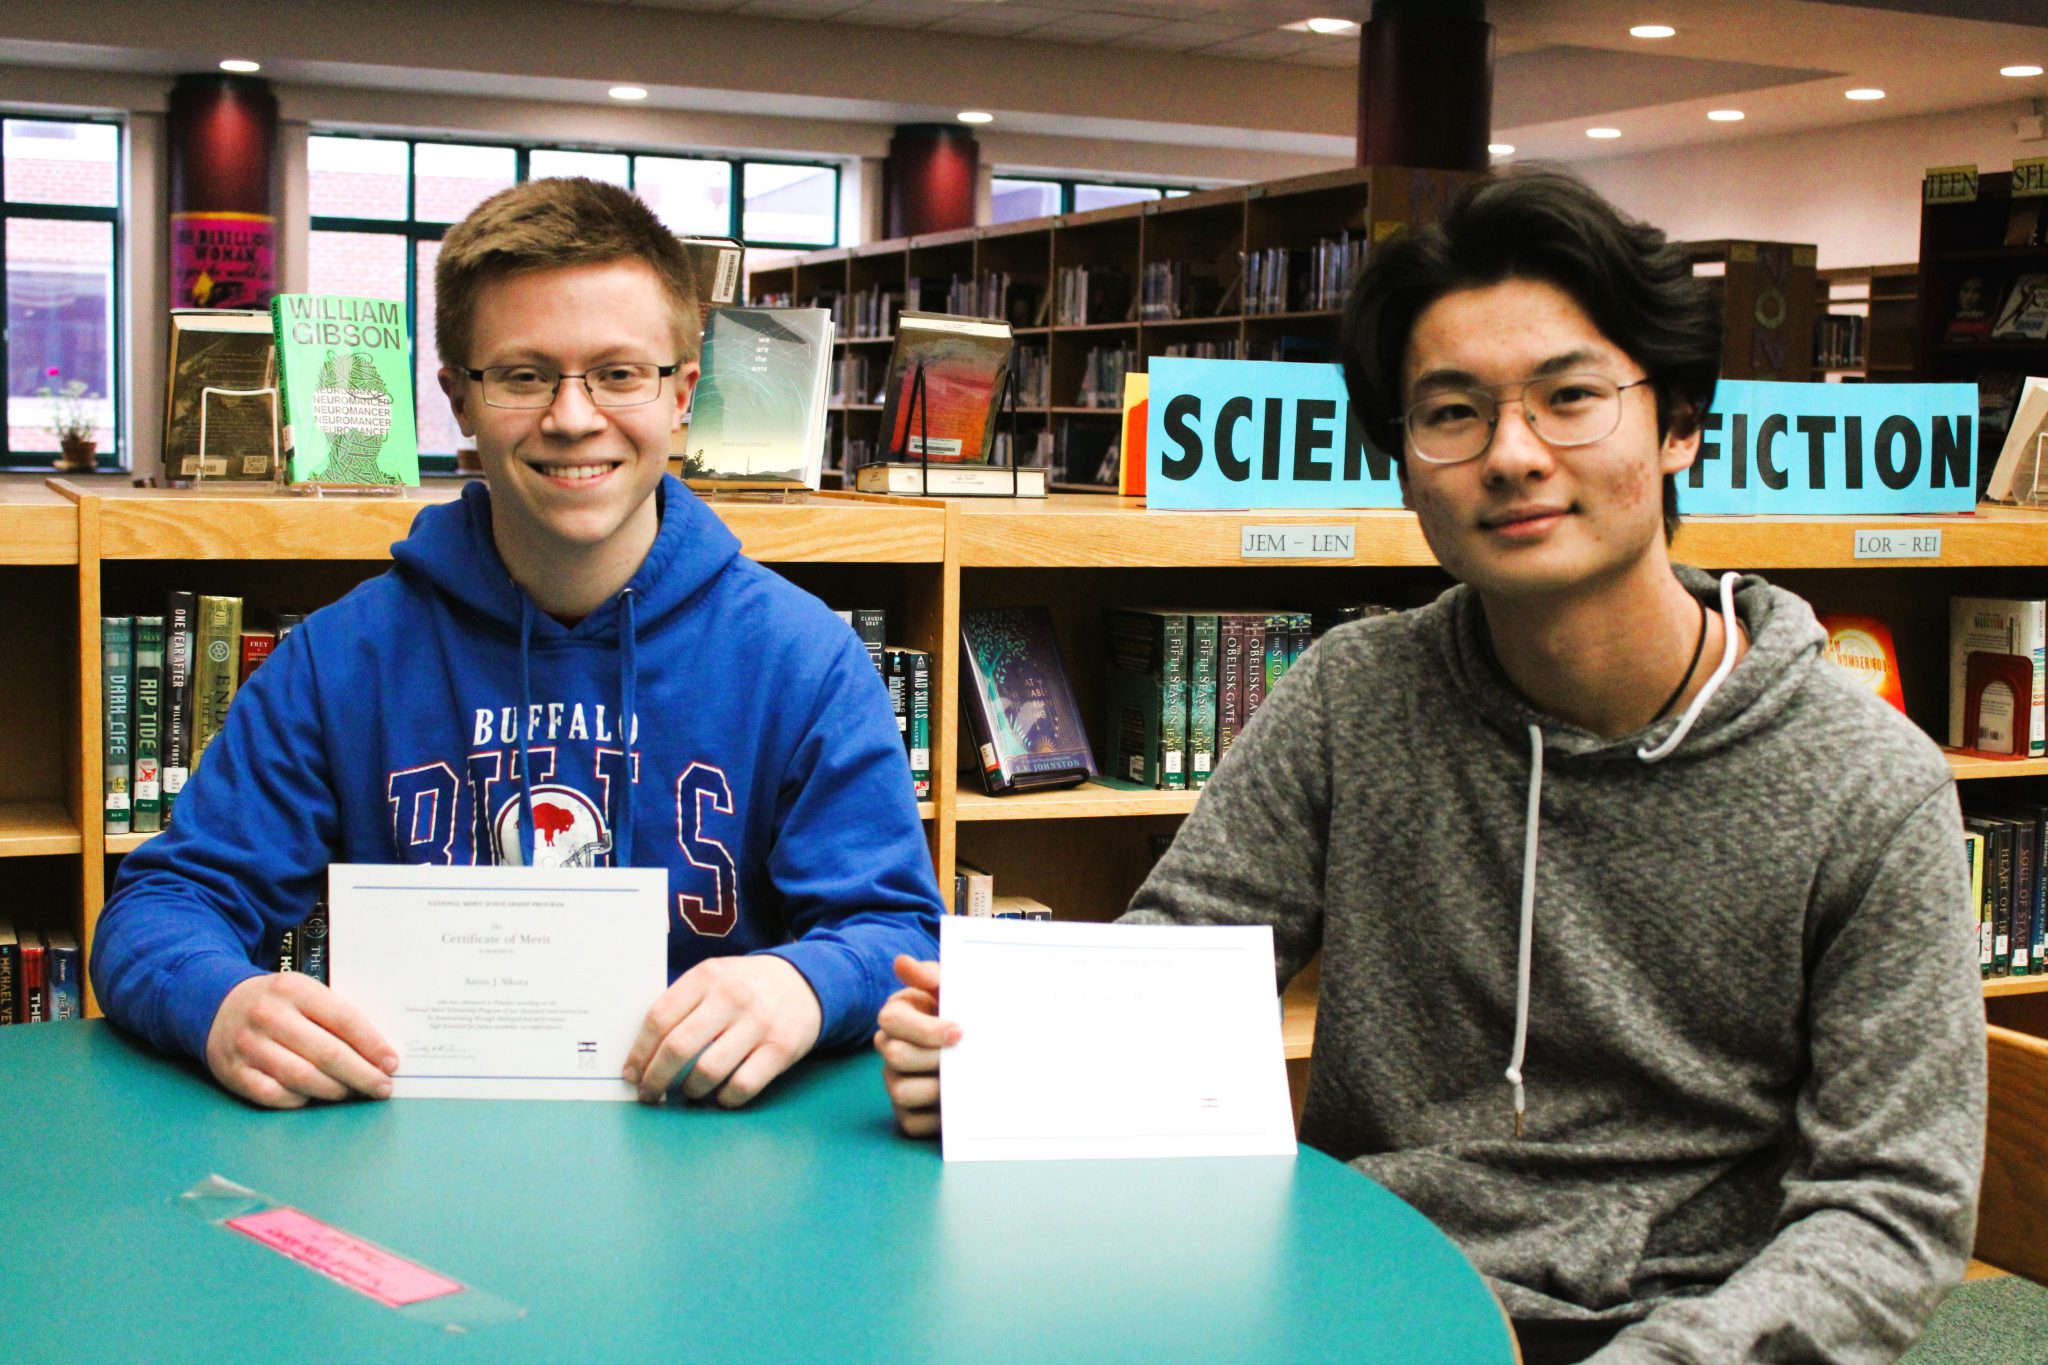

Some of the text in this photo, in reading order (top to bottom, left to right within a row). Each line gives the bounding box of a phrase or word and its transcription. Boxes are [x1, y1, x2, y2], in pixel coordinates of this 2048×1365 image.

[1927, 171, 1977, 199] TEEN
[289, 298, 399, 325] WILLIAM
[293, 323, 401, 350] GIBSON
[313, 395, 391, 407] NEUROMANCER
[313, 405, 391, 417] NEUROMANCER
[314, 415, 392, 427] NEUROMANCER
[1688, 413, 1972, 491] FICTION
[1245, 534, 1286, 552] JEM
[1312, 534, 1351, 552] LEN
[1858, 537, 1891, 553] LOR
[1912, 536, 1938, 552] REI
[174, 608, 186, 628] ONE
[173, 631, 186, 657] YEAR
[1169, 638, 1181, 672] FIFTH
[1199, 638, 1210, 672] FIFTH
[172, 658, 185, 688] AFTER
[1226, 637, 1237, 690] OBELISK
[1249, 638, 1260, 692] OBELISK
[1837, 654, 1870, 670] NUMBER
[914, 669, 929, 689] MAD
[139, 679, 158, 749] RIP TIDE
[914, 690, 929, 719] SKILLS
[1169, 676, 1181, 725] SEASON
[1198, 676, 1210, 725] SEASON
[1225, 692, 1235, 724] GATE
[110, 675, 127, 755] DARK LIFE
[173, 705, 181, 735] WILLIAM
[473, 703, 639, 746] BUFFALO
[1034, 760, 1080, 772] JOHNSTON
[1998, 848, 2010, 891] HEART
[2019, 848, 2030, 884] SOUL
[1999, 897, 2008, 914] OF
[2019, 889, 2028, 906] OF
[441, 933, 551, 945] Certificate of Merit
[310, 945, 321, 972] THE
[0, 957, 12, 1004] MICHAEL
